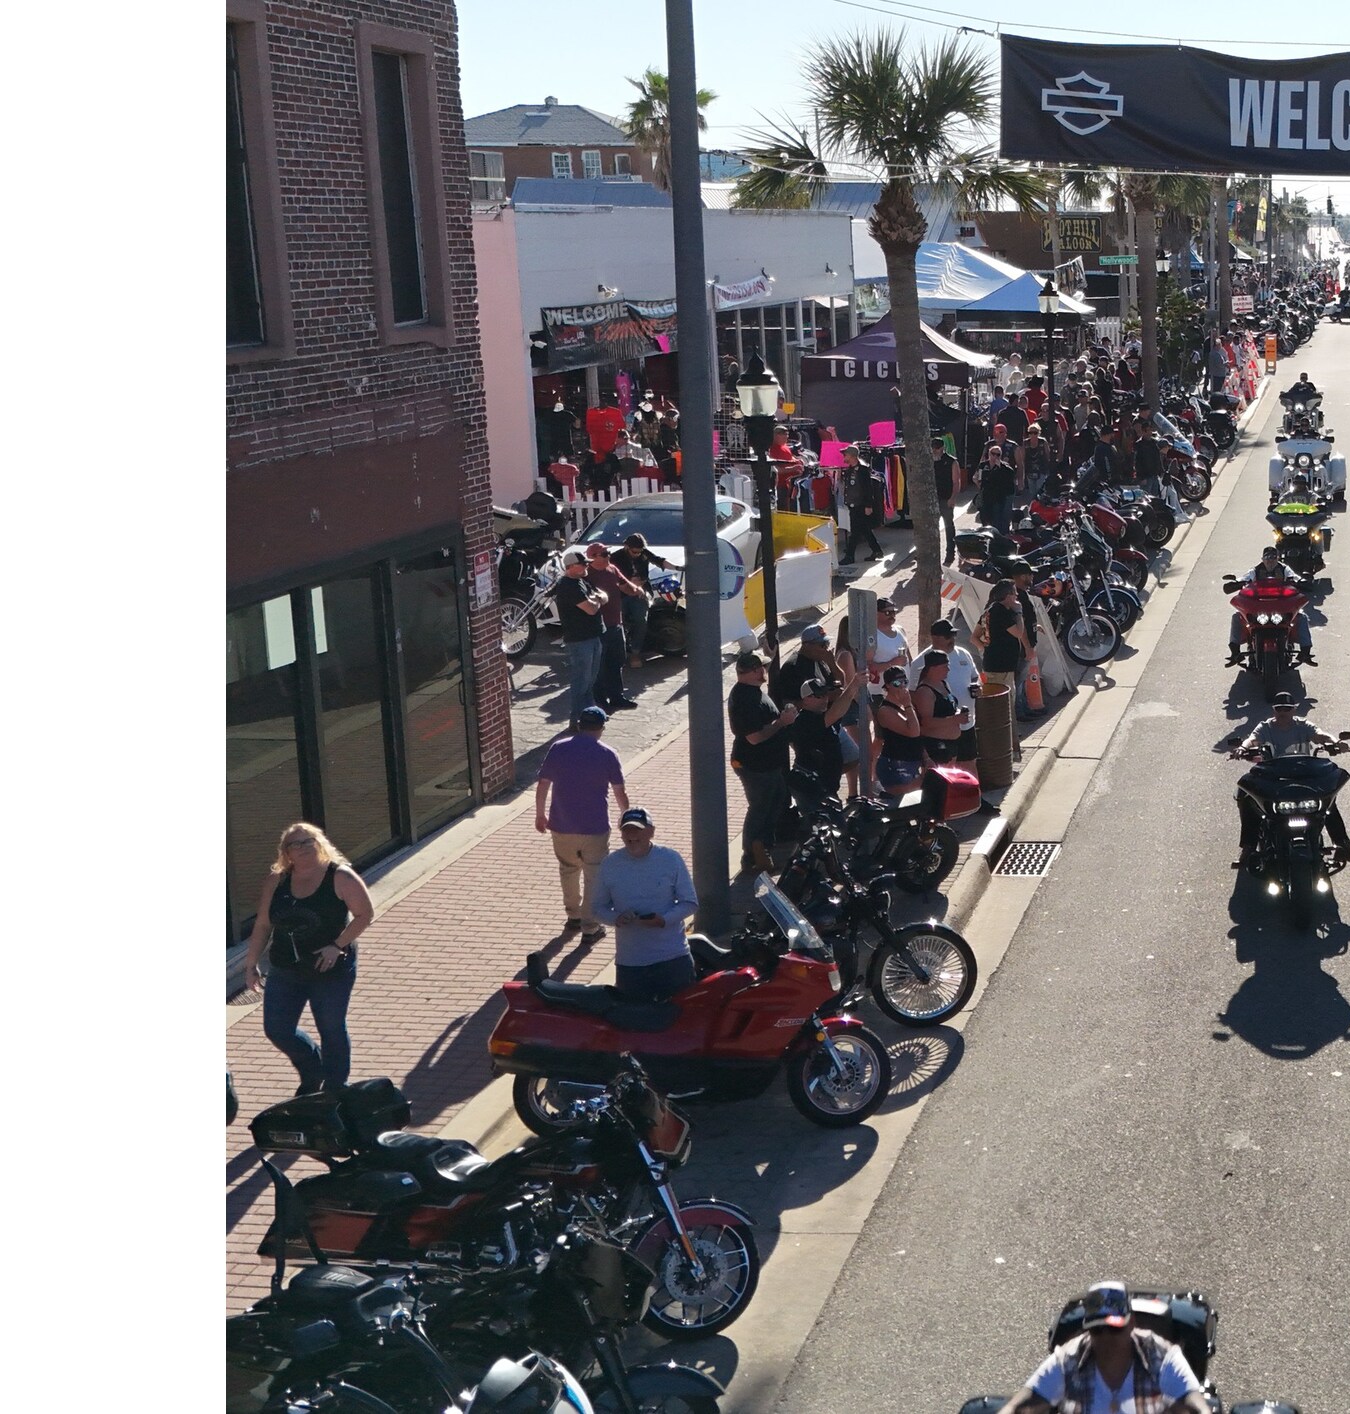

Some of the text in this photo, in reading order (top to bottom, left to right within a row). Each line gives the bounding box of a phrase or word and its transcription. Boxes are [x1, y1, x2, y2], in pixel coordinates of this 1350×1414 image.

[1044, 219, 1100, 248] BOTHILL
[1060, 237, 1093, 250] ALOON
[545, 302, 630, 326] WELCOME
[831, 360, 939, 381] ICICS
